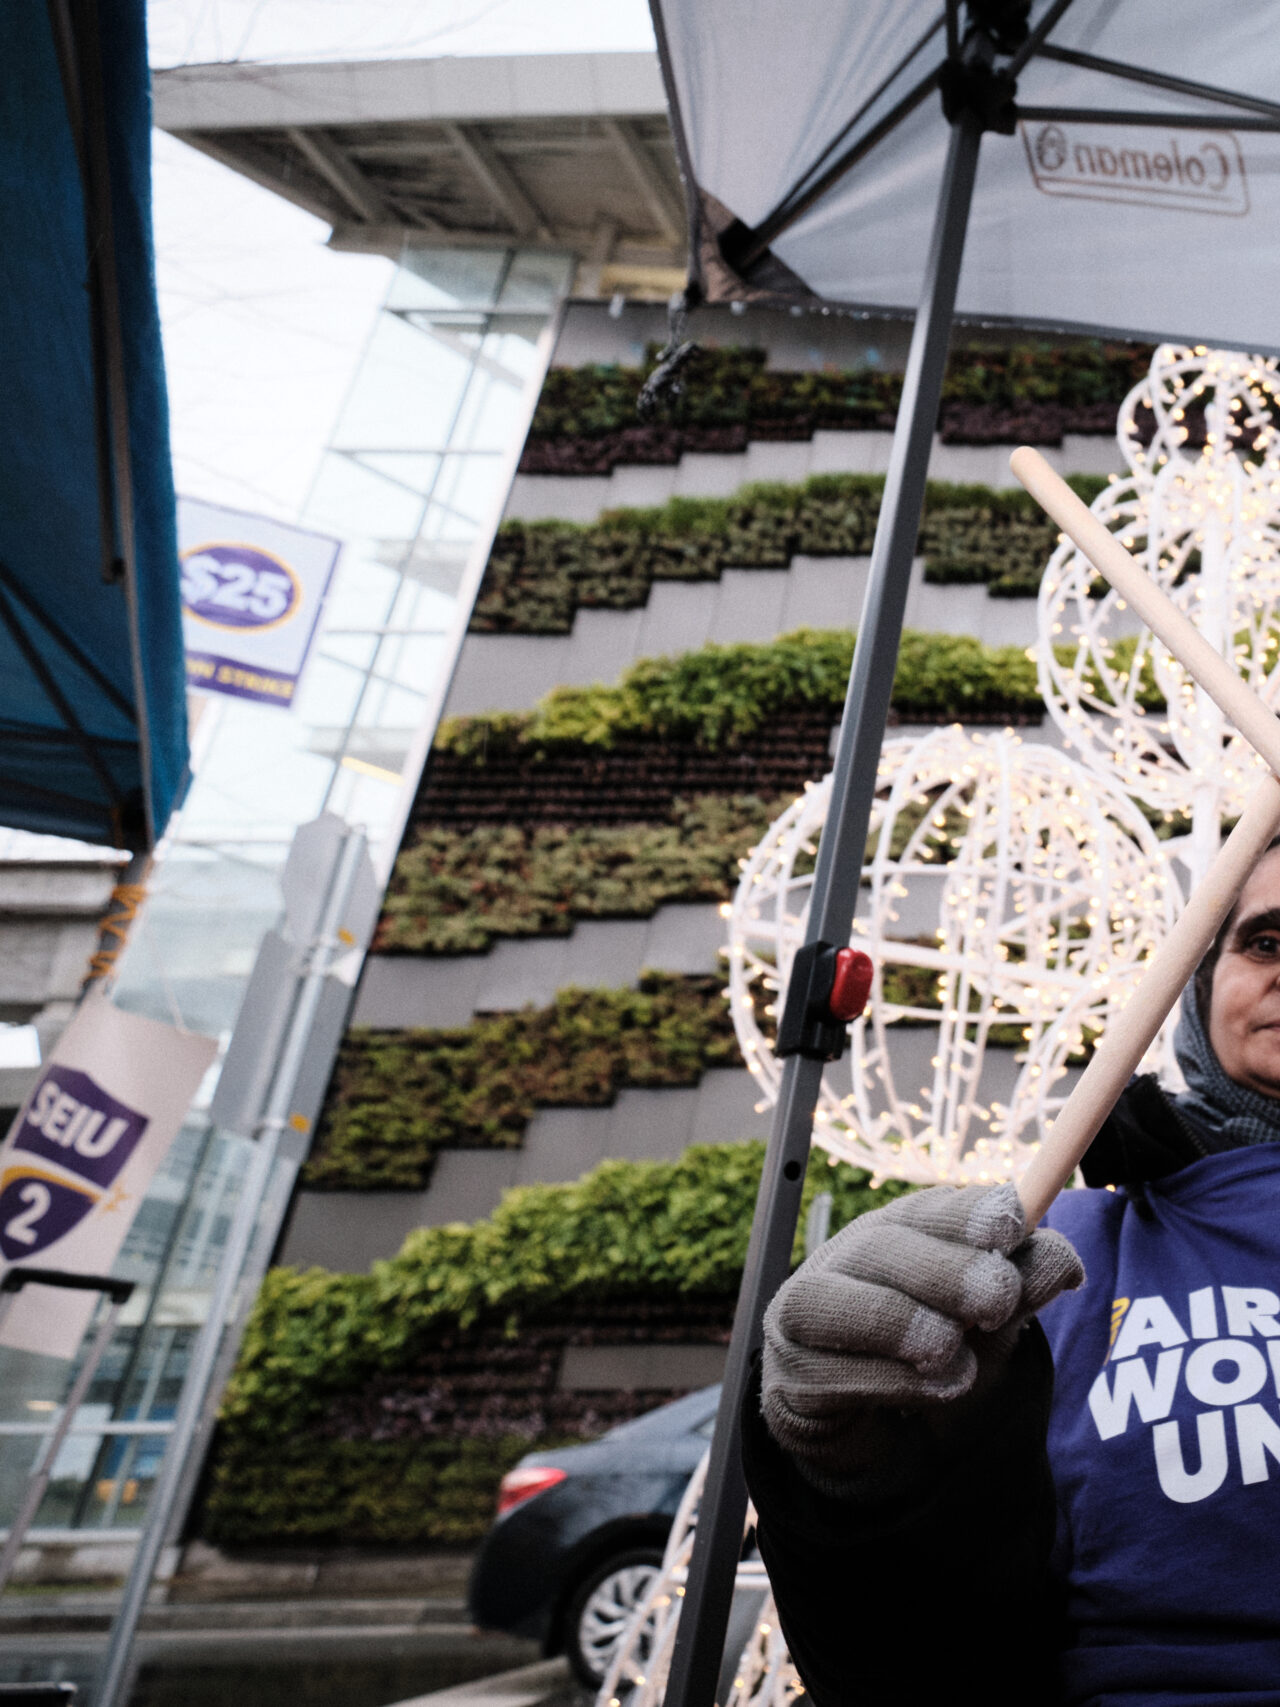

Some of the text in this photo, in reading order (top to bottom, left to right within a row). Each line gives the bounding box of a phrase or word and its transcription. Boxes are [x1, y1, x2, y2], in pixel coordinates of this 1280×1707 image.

[181, 555, 292, 619] $25
[26, 1080, 130, 1159] SEIU
[5, 1182, 52, 1246] 2
